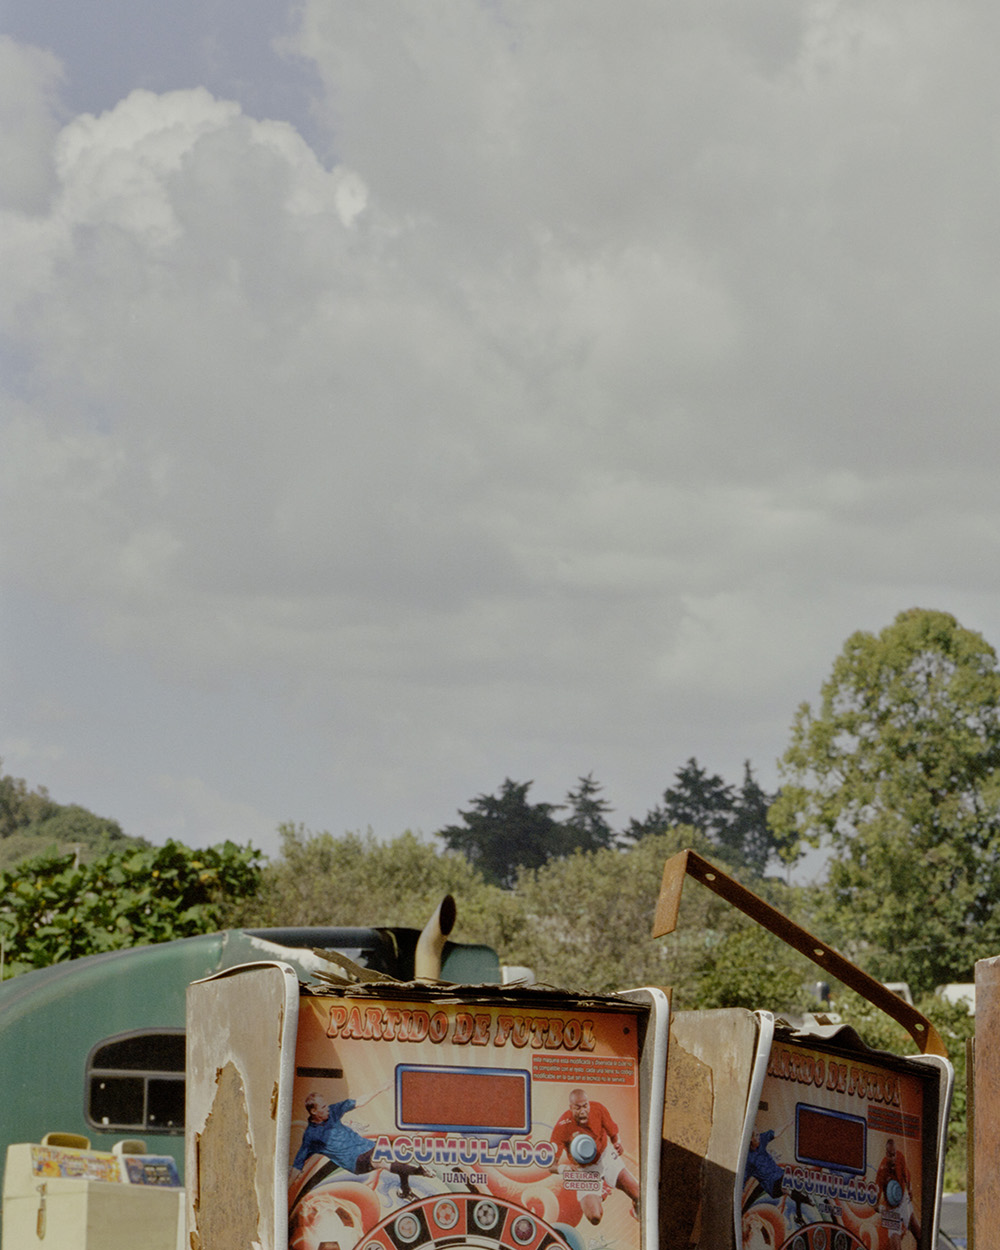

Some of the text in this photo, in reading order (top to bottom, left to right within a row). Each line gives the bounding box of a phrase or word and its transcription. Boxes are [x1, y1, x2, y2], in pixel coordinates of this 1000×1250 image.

[327, 1005, 596, 1051] PARTIDO DE FUTBOL
[768, 1046, 825, 1088] ARTIDO
[826, 1061, 848, 1094] DE
[371, 1135, 557, 1168] ACUMULADO
[442, 1172, 487, 1184] JUAN CHI
[563, 1171, 599, 1180] RETIRAR
[564, 1181, 600, 1190] CREDITO
[781, 1165, 880, 1207] ACUMULADO
